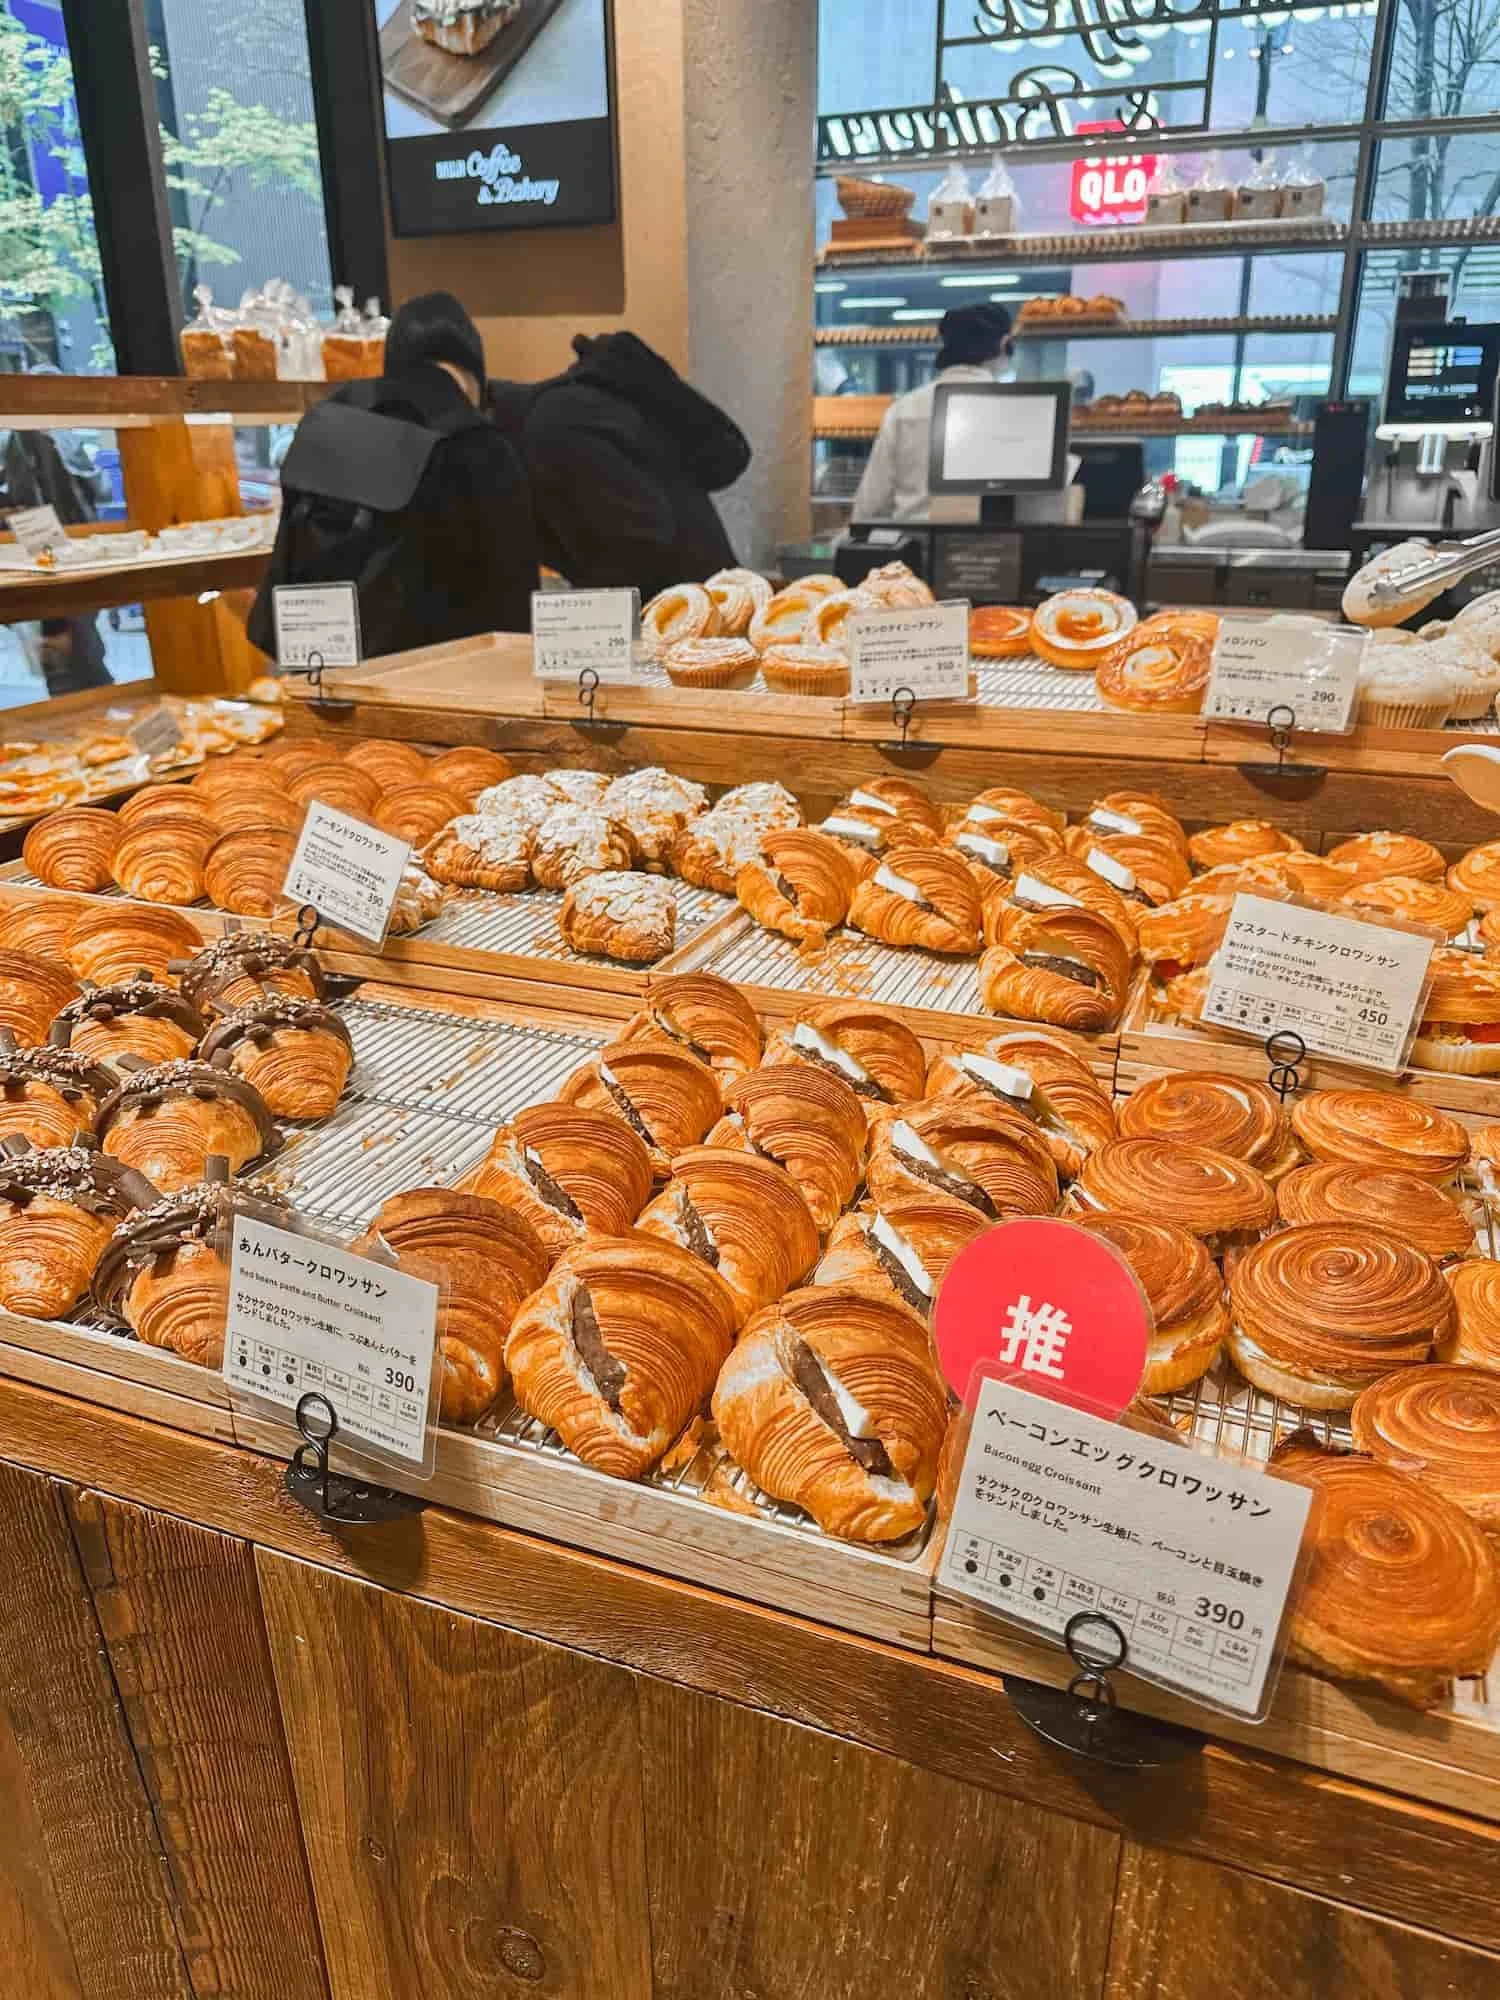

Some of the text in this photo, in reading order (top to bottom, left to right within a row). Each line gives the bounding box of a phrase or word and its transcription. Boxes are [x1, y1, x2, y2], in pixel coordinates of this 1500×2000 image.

[1080, 168, 1147, 210] QLO
[1232, 920, 1400, 969] マスタードチキンクロワッサン
[1357, 1007, 1388, 1025] 450
[239, 1234, 387, 1303] あんバタークロワッサン
[999, 1295, 1073, 1379] 推
[384, 1366, 414, 1393] 390
[983, 1443, 1102, 1495] Bacon egg Croissant
[986, 1405, 1272, 1523] ベーコンエッグクロワッサン
[1193, 1595, 1245, 1632] 390
